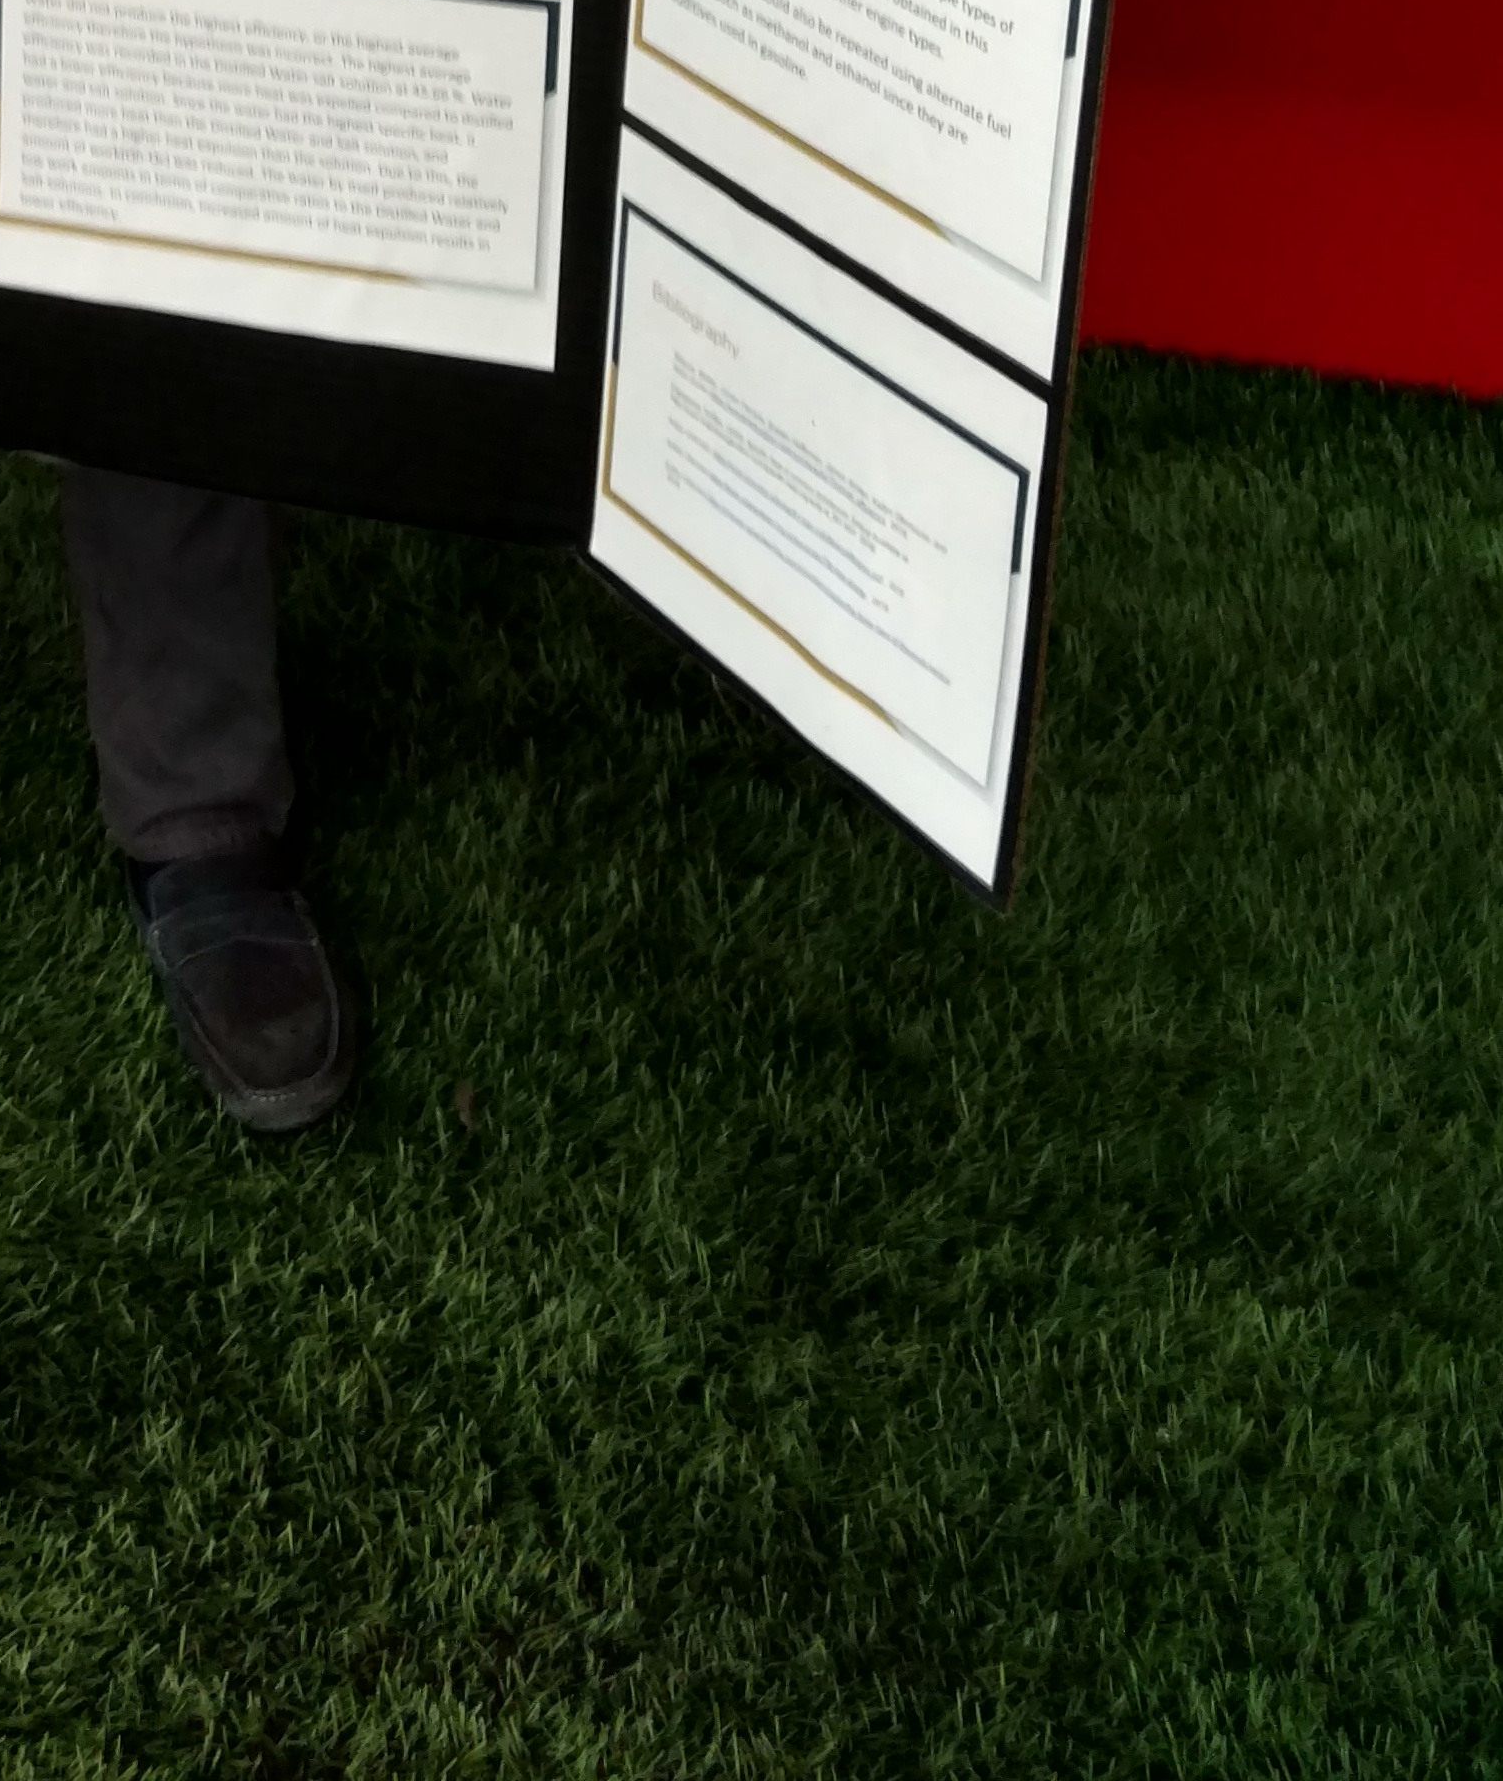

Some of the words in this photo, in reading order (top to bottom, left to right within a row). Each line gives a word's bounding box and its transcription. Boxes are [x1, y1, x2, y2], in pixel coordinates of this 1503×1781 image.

[865, 7, 905, 38] engine
[949, 17, 960, 39] in
[964, 25, 989, 54] this
[999, 18, 1014, 38] of
[742, 6, 753, 23] as
[756, 14, 809, 54] methanol
[812, 47, 833, 68] and
[835, 60, 881, 96] ethanol
[882, 87, 913, 115] since
[917, 103, 944, 136] they
[947, 124, 968, 147] are
[792, 5, 815, 29] also
[817, 16, 832, 39] be
[835, 31, 888, 71] repeated
[891, 63, 922, 94] using
[926, 82, 983, 125] alternate
[987, 112, 1011, 141] fuel
[652, 279, 740, 362] Bibliography
